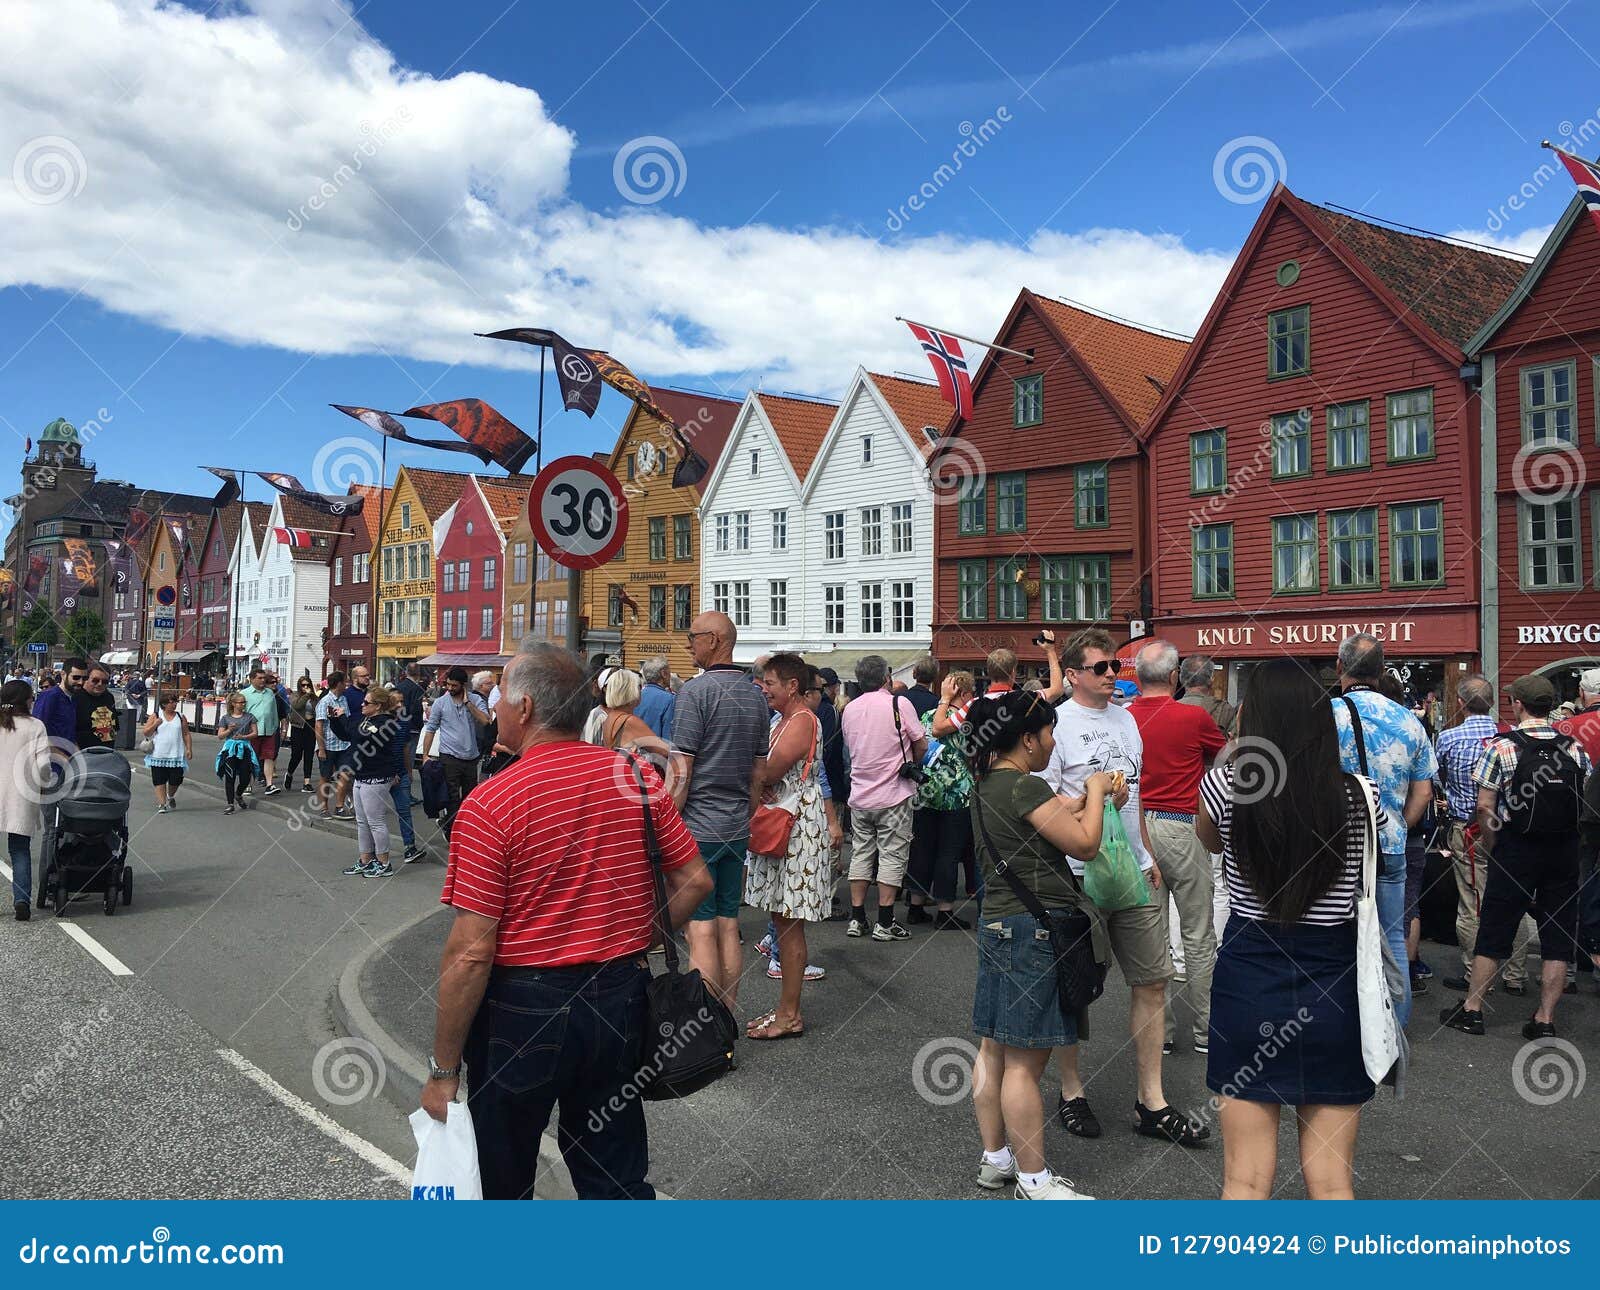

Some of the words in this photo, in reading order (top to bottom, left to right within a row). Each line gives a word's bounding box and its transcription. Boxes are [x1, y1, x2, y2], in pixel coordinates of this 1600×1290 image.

[550, 483, 612, 540] 30
[156, 619, 174, 627] Taxi
[1197, 627, 1256, 646] KNUT
